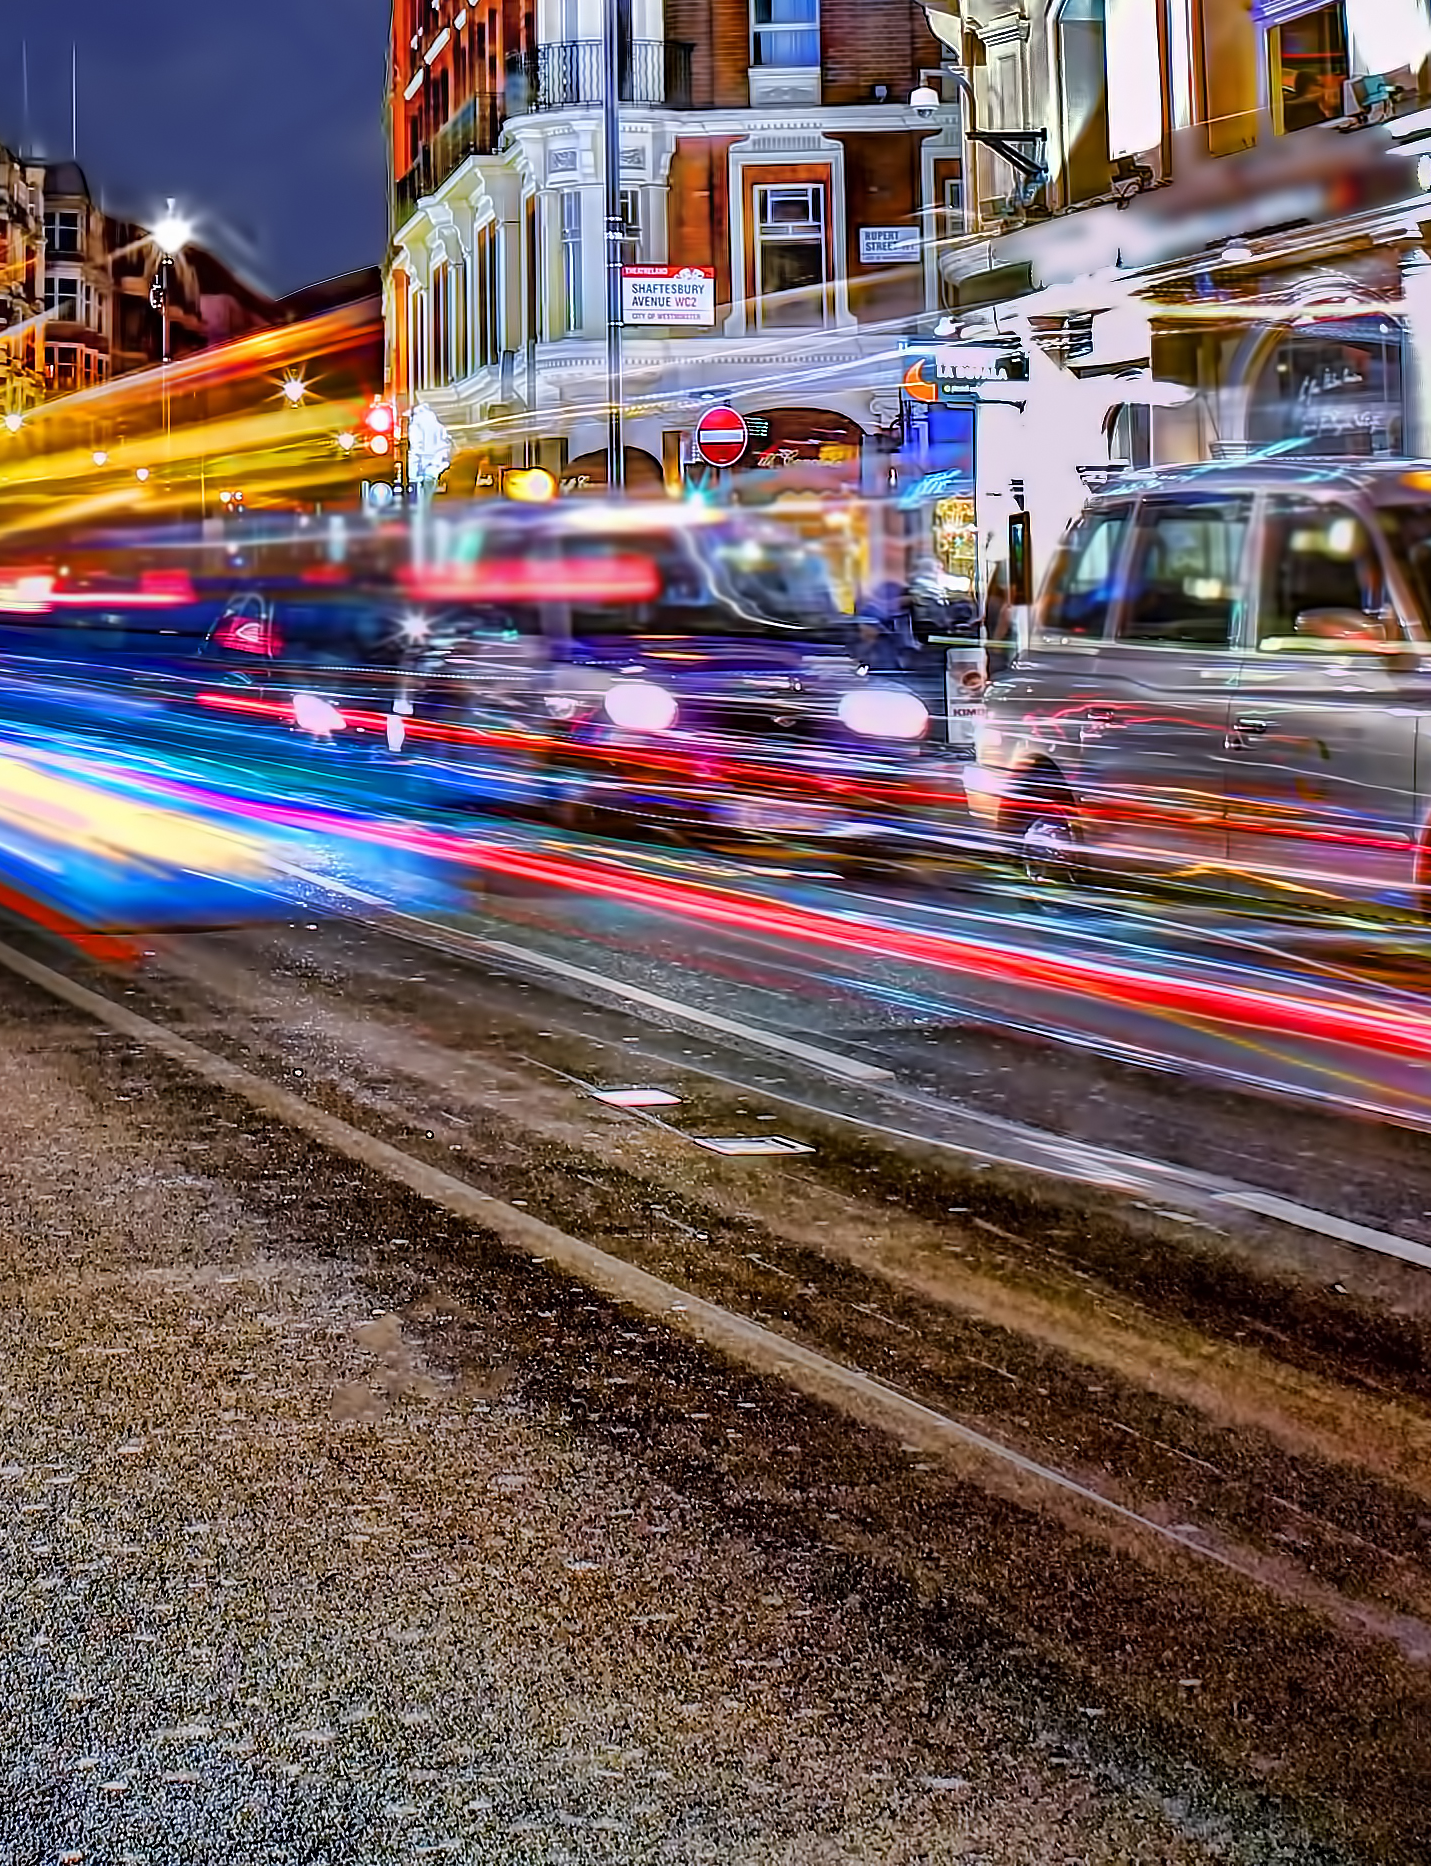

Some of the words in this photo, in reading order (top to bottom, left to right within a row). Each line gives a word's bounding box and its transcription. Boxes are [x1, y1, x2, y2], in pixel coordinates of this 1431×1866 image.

[864, 230, 899, 240] RUPERT
[631, 283, 705, 294] SHAFTESBURY
[631, 296, 671, 307] AVENUE
[675, 296, 697, 307] WC2
